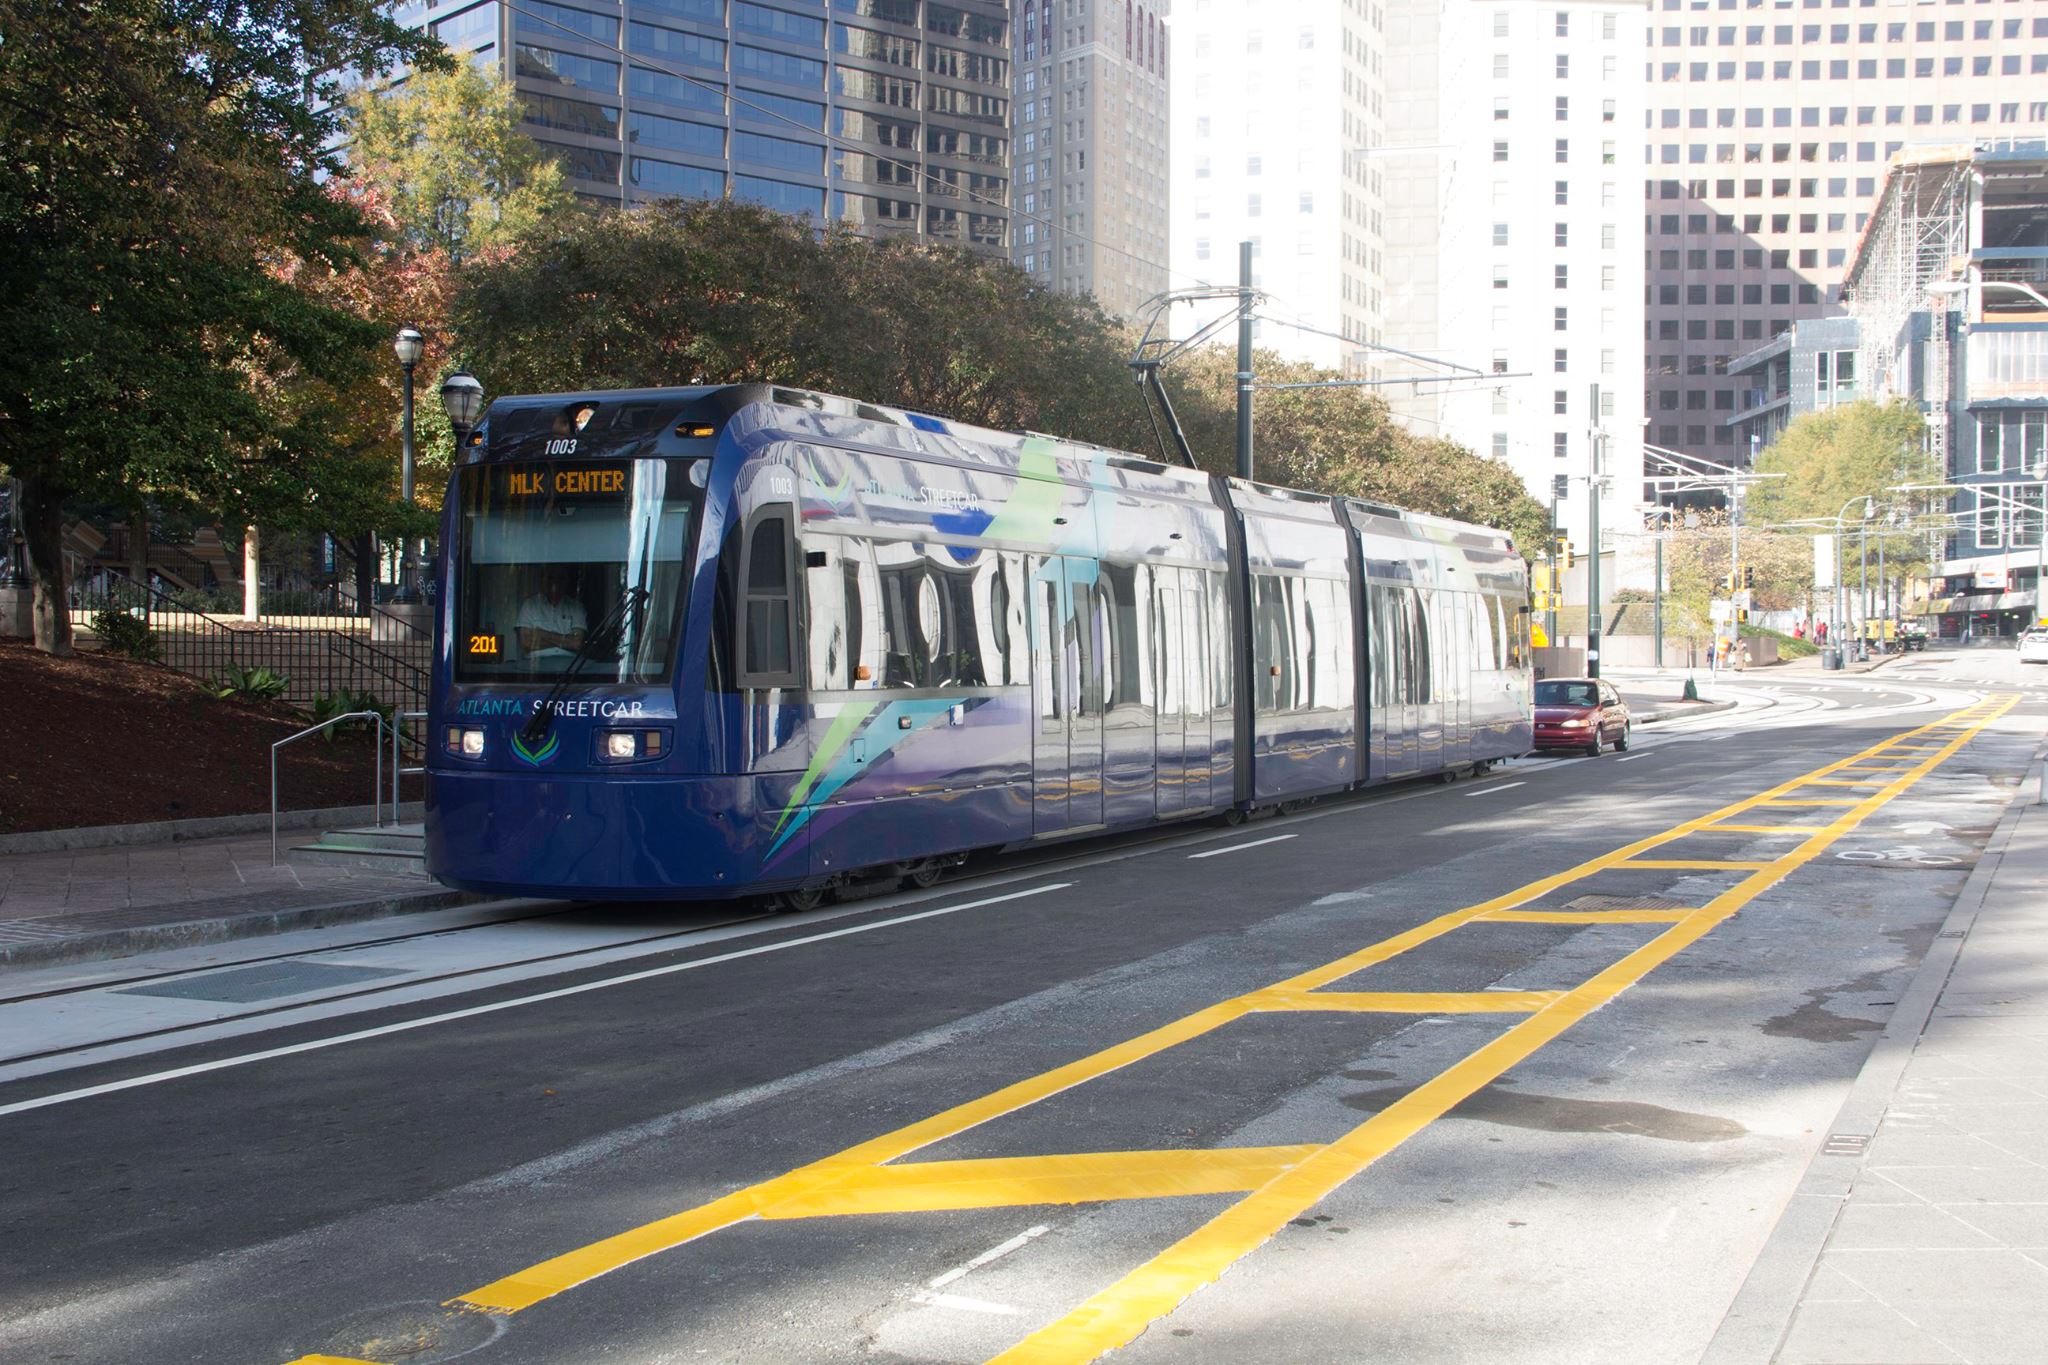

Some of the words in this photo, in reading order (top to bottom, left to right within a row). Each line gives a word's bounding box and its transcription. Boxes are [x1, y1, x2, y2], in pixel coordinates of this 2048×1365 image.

[545, 438, 577, 455] 1003
[510, 472, 545, 495] MLK
[555, 469, 625, 493] CENTER
[769, 476, 793, 495] 1003
[920, 485, 980, 512] STREETCAR
[470, 635, 498, 653] 201
[456, 699, 523, 716] ATLANTA
